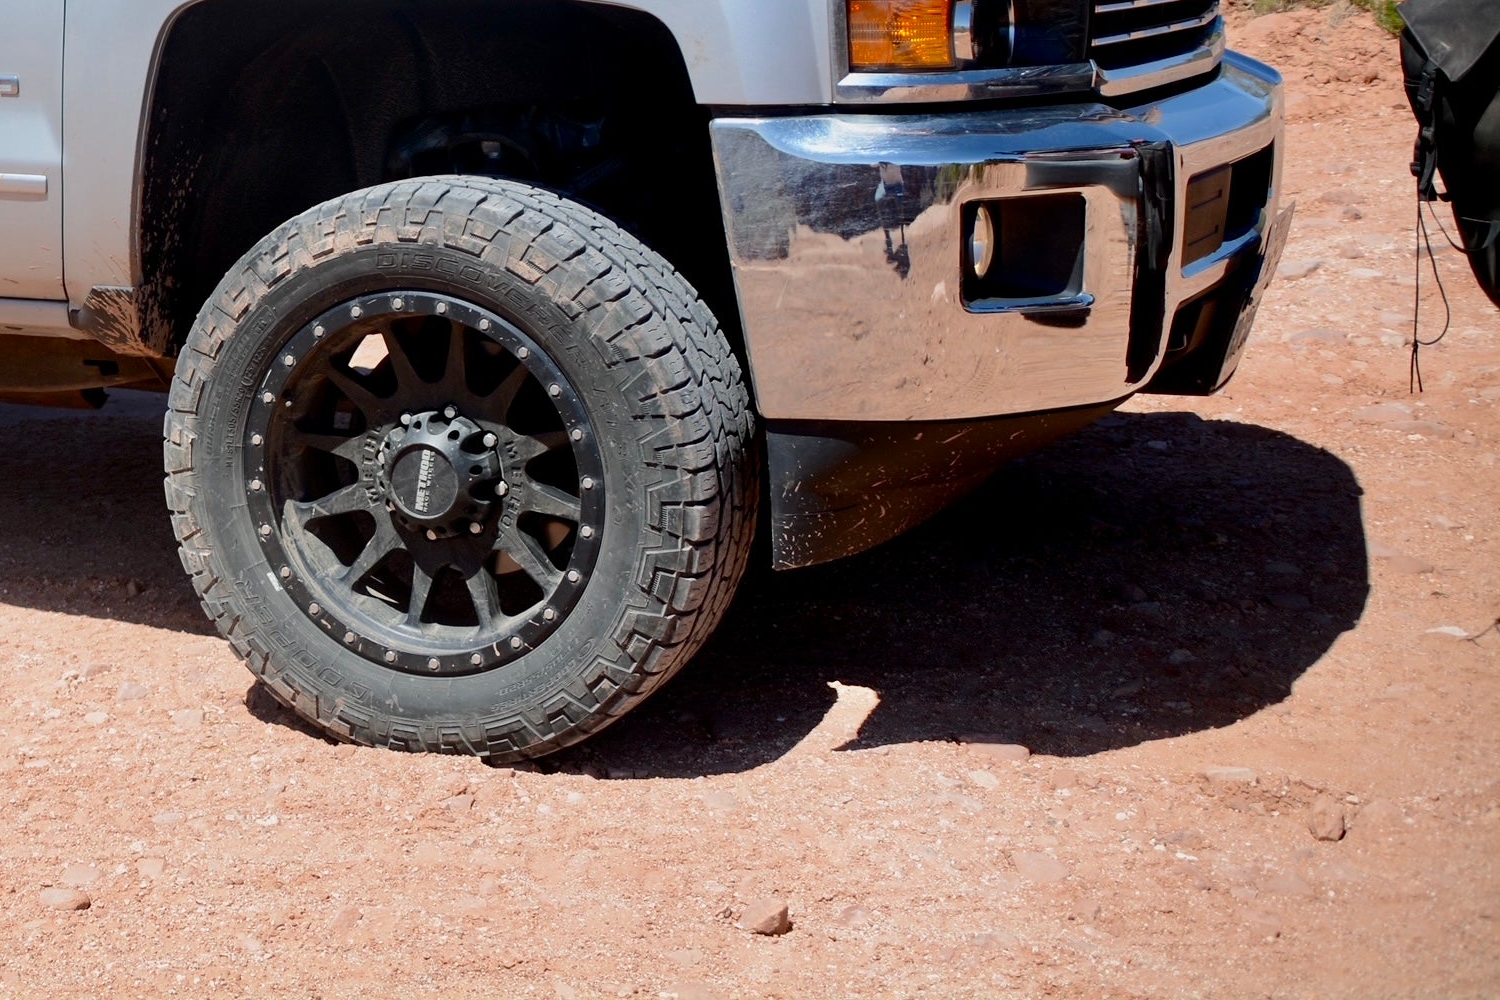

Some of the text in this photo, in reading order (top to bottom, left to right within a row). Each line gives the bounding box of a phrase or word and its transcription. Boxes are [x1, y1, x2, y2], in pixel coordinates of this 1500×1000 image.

[375, 252, 590, 370] DISCOVERER
[362, 425, 384, 507] METH
[414, 449, 431, 511] METHOD
[233, 574, 376, 705] COOPER
